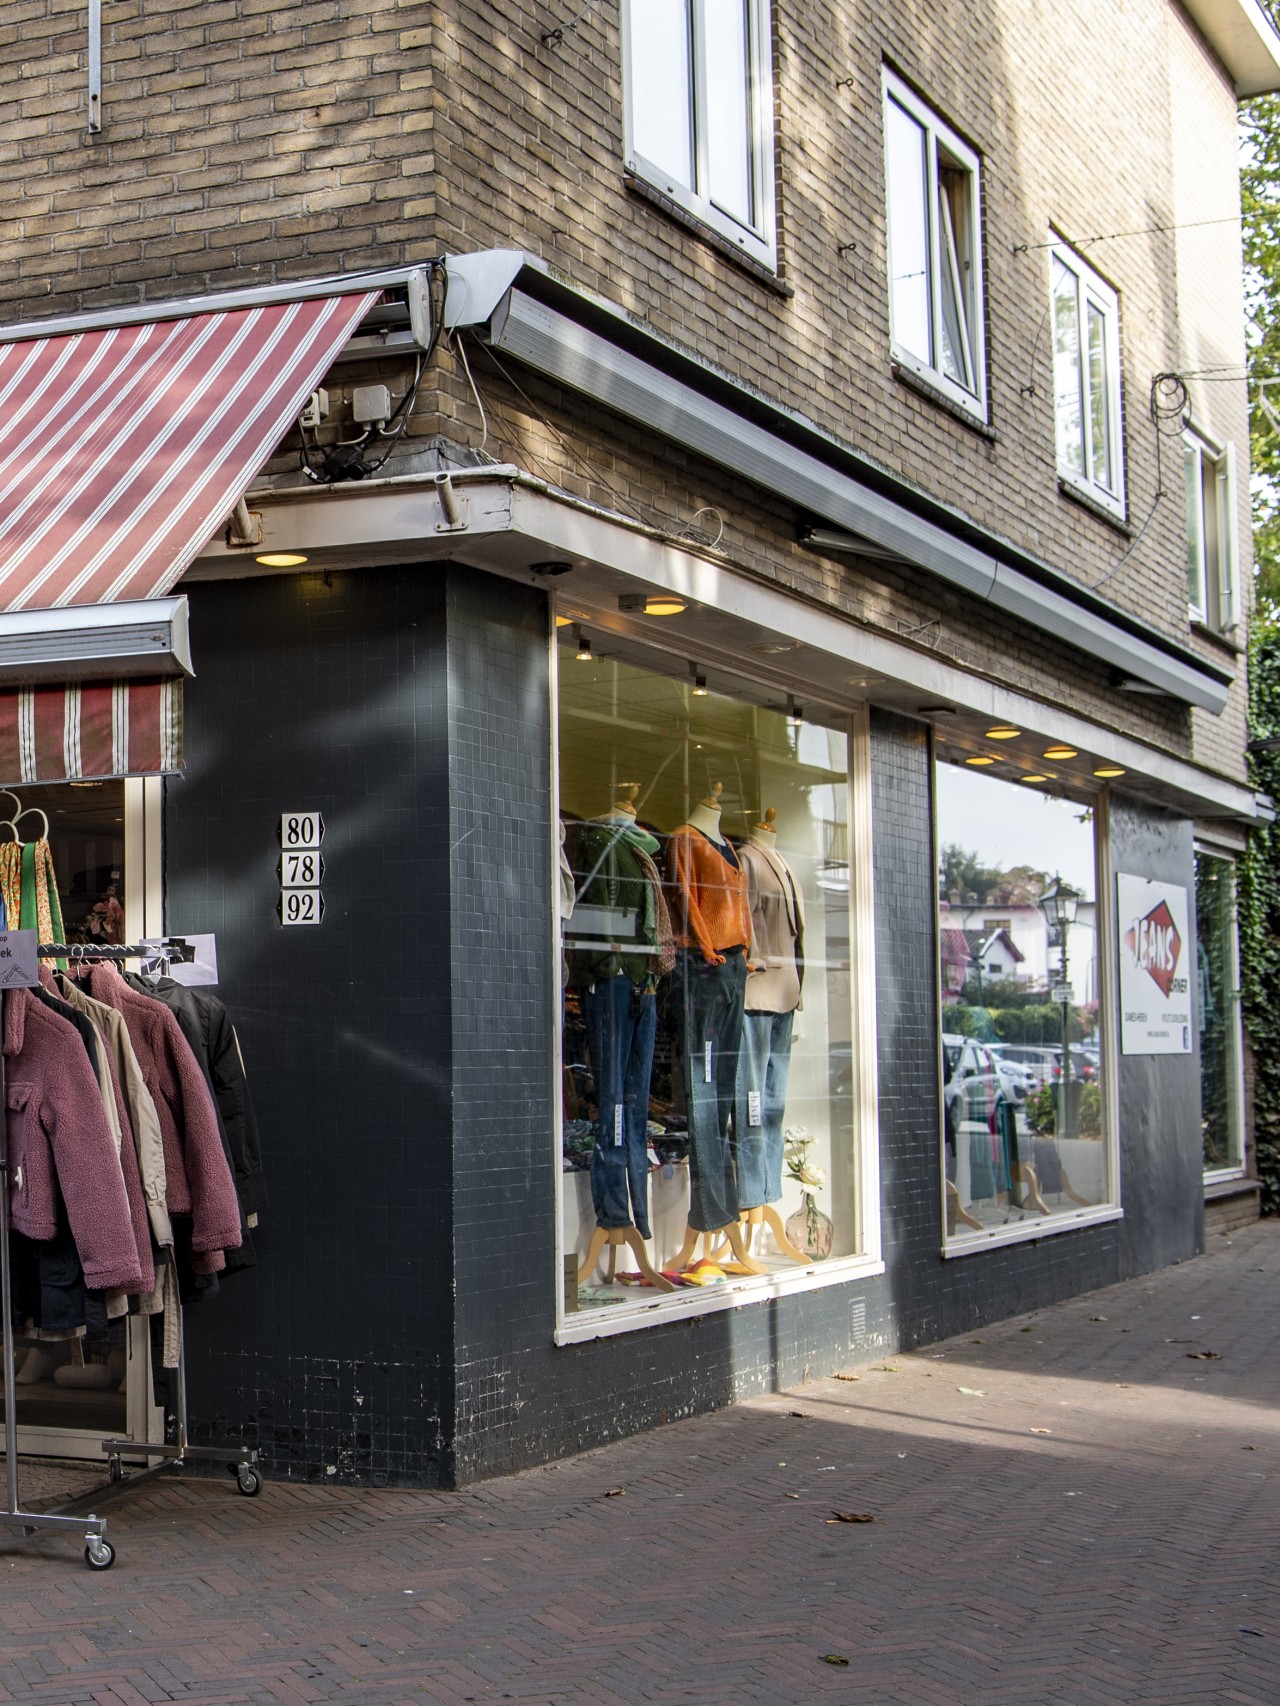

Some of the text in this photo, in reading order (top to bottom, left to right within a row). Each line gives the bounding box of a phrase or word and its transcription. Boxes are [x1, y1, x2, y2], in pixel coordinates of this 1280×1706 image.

[287, 816, 314, 845] 80
[287, 855, 314, 883] 78
[287, 894, 314, 922] 92
[0, 935, 8, 943] op
[1131, 918, 1174, 971] JEANS
